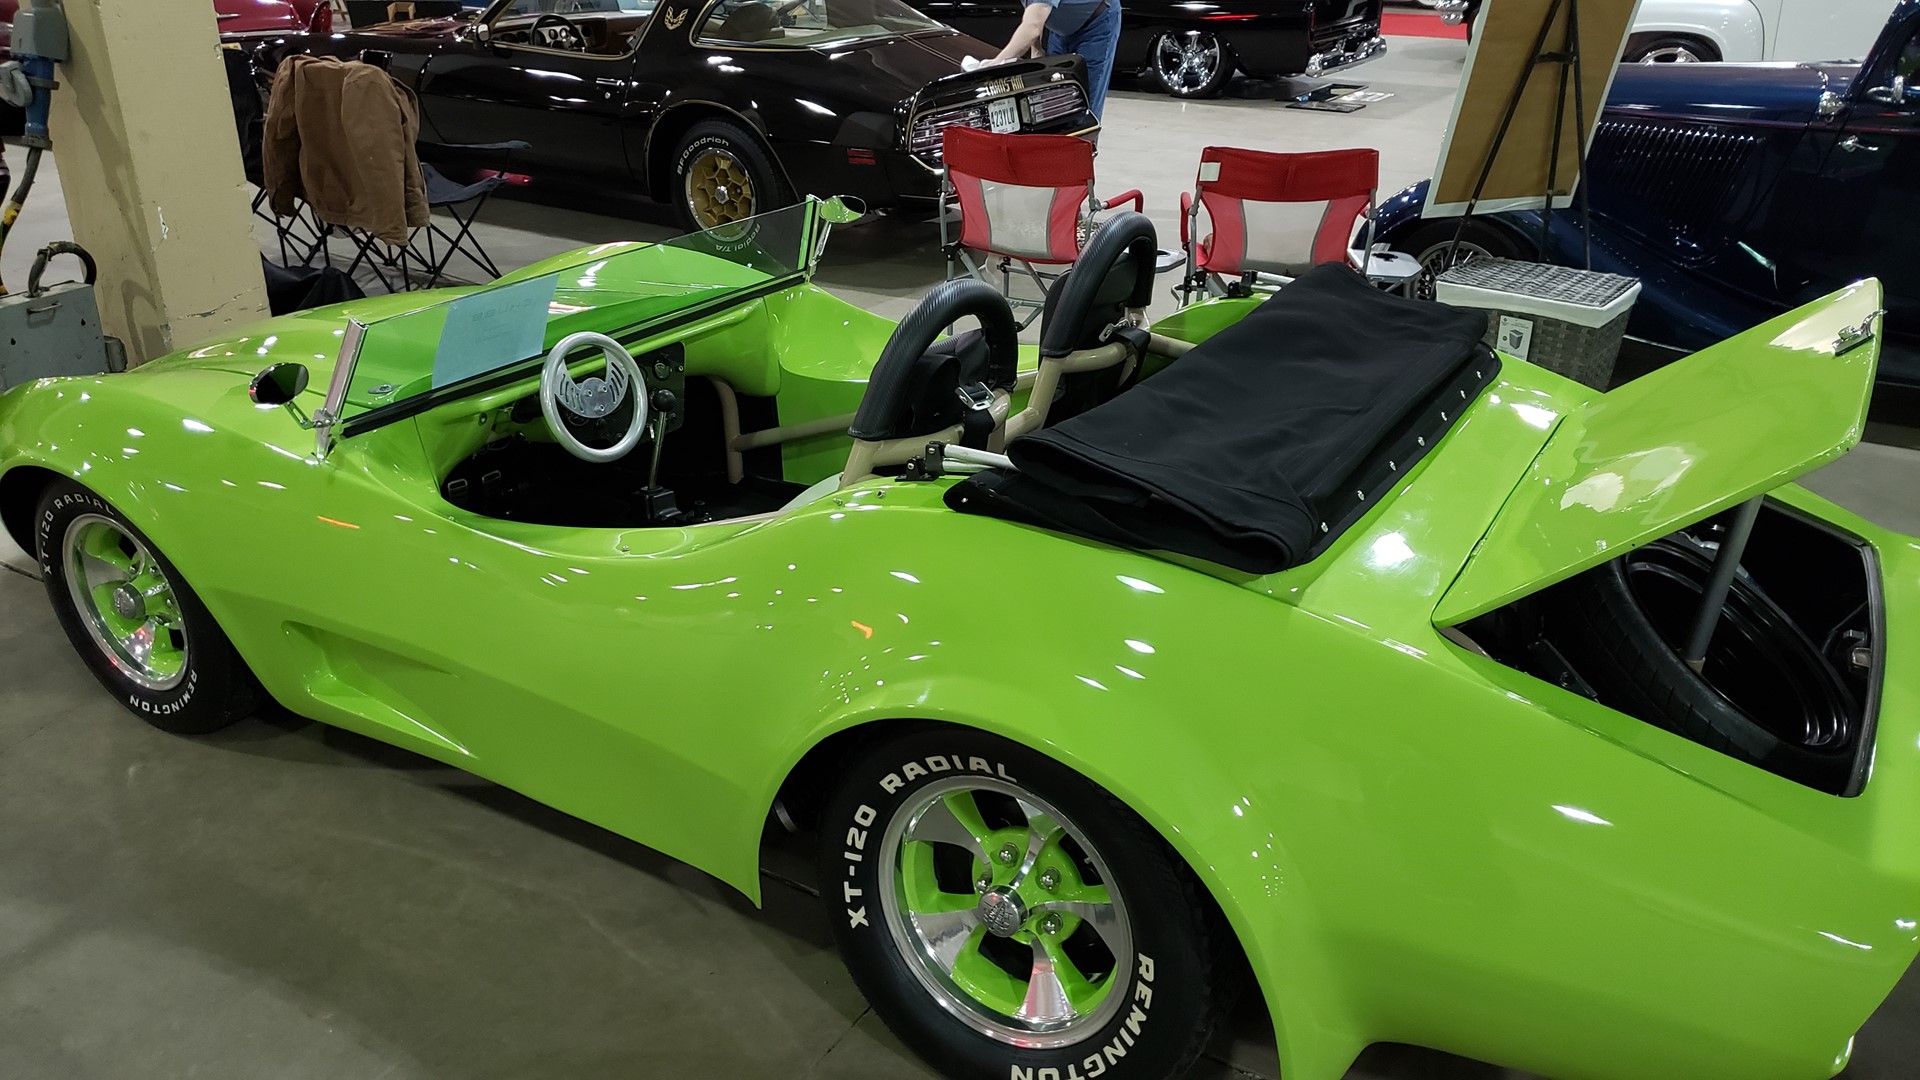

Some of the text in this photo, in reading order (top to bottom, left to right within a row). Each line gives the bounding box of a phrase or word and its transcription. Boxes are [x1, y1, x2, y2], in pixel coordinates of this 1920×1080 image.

[677, 136, 729, 175] BFGoodrich
[39, 493, 115, 576] XT-120 RADIAL
[129, 669, 198, 715] REMINGTON
[842, 755, 1018, 930] XT-120 RADIAL
[1010, 952, 1155, 1080] REMINGTON
